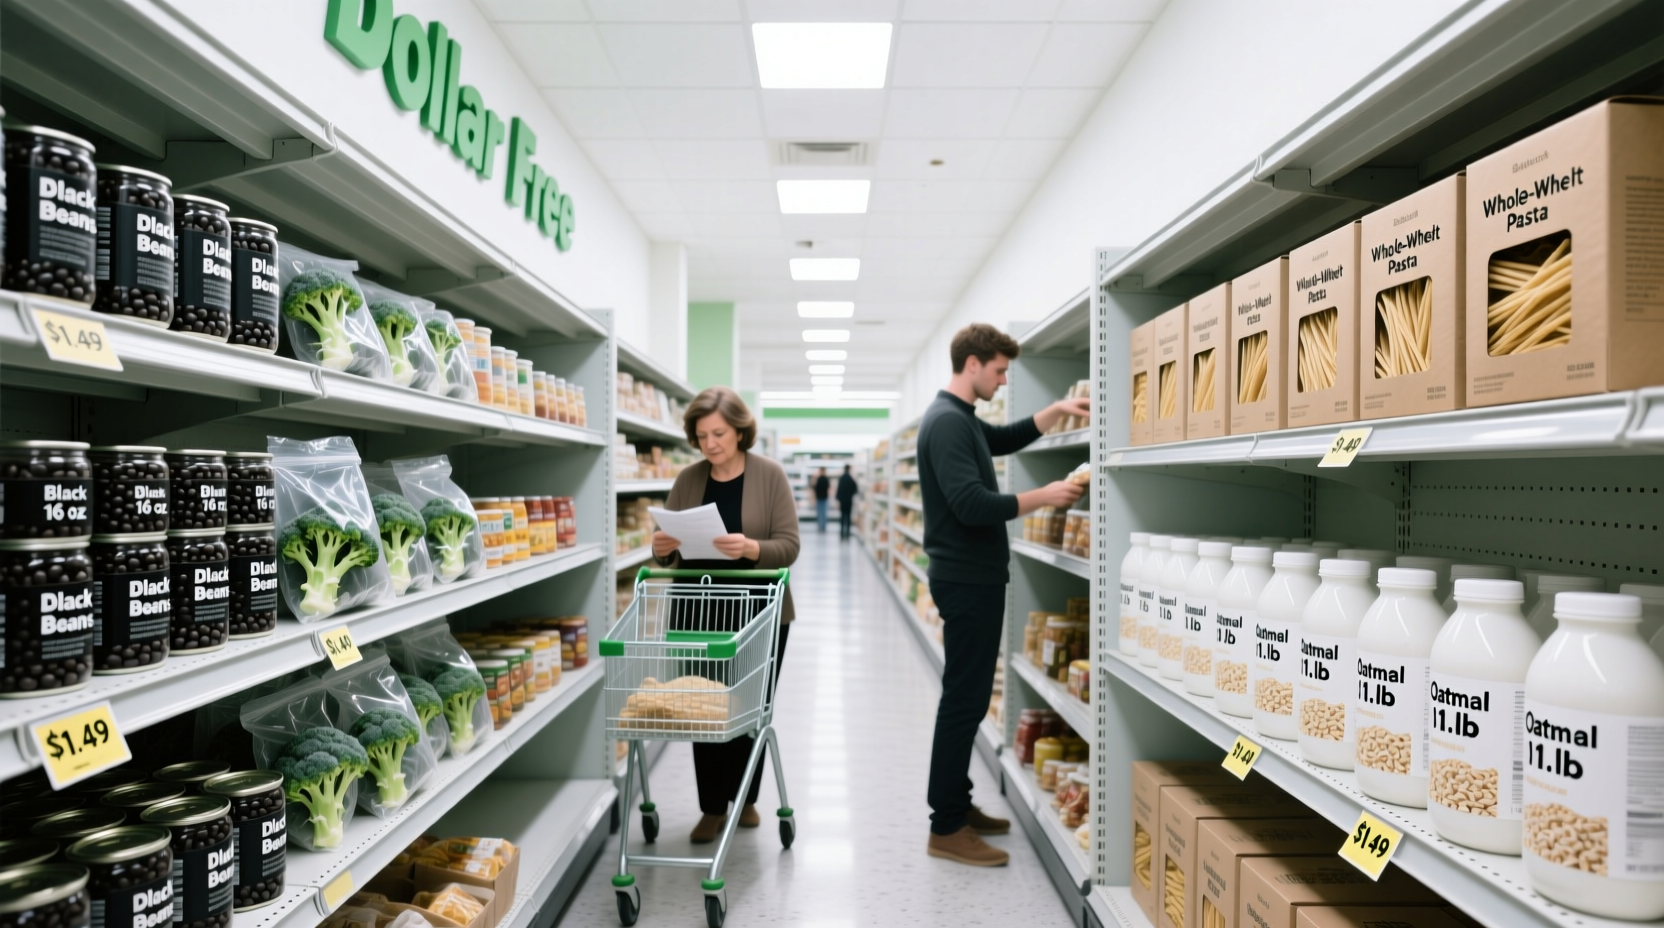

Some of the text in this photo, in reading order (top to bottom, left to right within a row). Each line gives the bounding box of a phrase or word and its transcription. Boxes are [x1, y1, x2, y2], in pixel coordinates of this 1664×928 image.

[323, 0, 575, 252] Dollar Free
[1507, 206, 1548, 233] Pasta
[1388, 255, 1418, 276] Pasta
[44, 320, 103, 352] $1.49
[44, 484, 87, 502] Black
[43, 503, 87, 521] 16 oz
[135, 499, 152, 515] 16
[1357, 657, 1405, 684] Oatmal
[1431, 680, 1490, 712] Oatmal
[46, 719, 110, 761] $1.49
[1525, 711, 1598, 749] Oatmal
